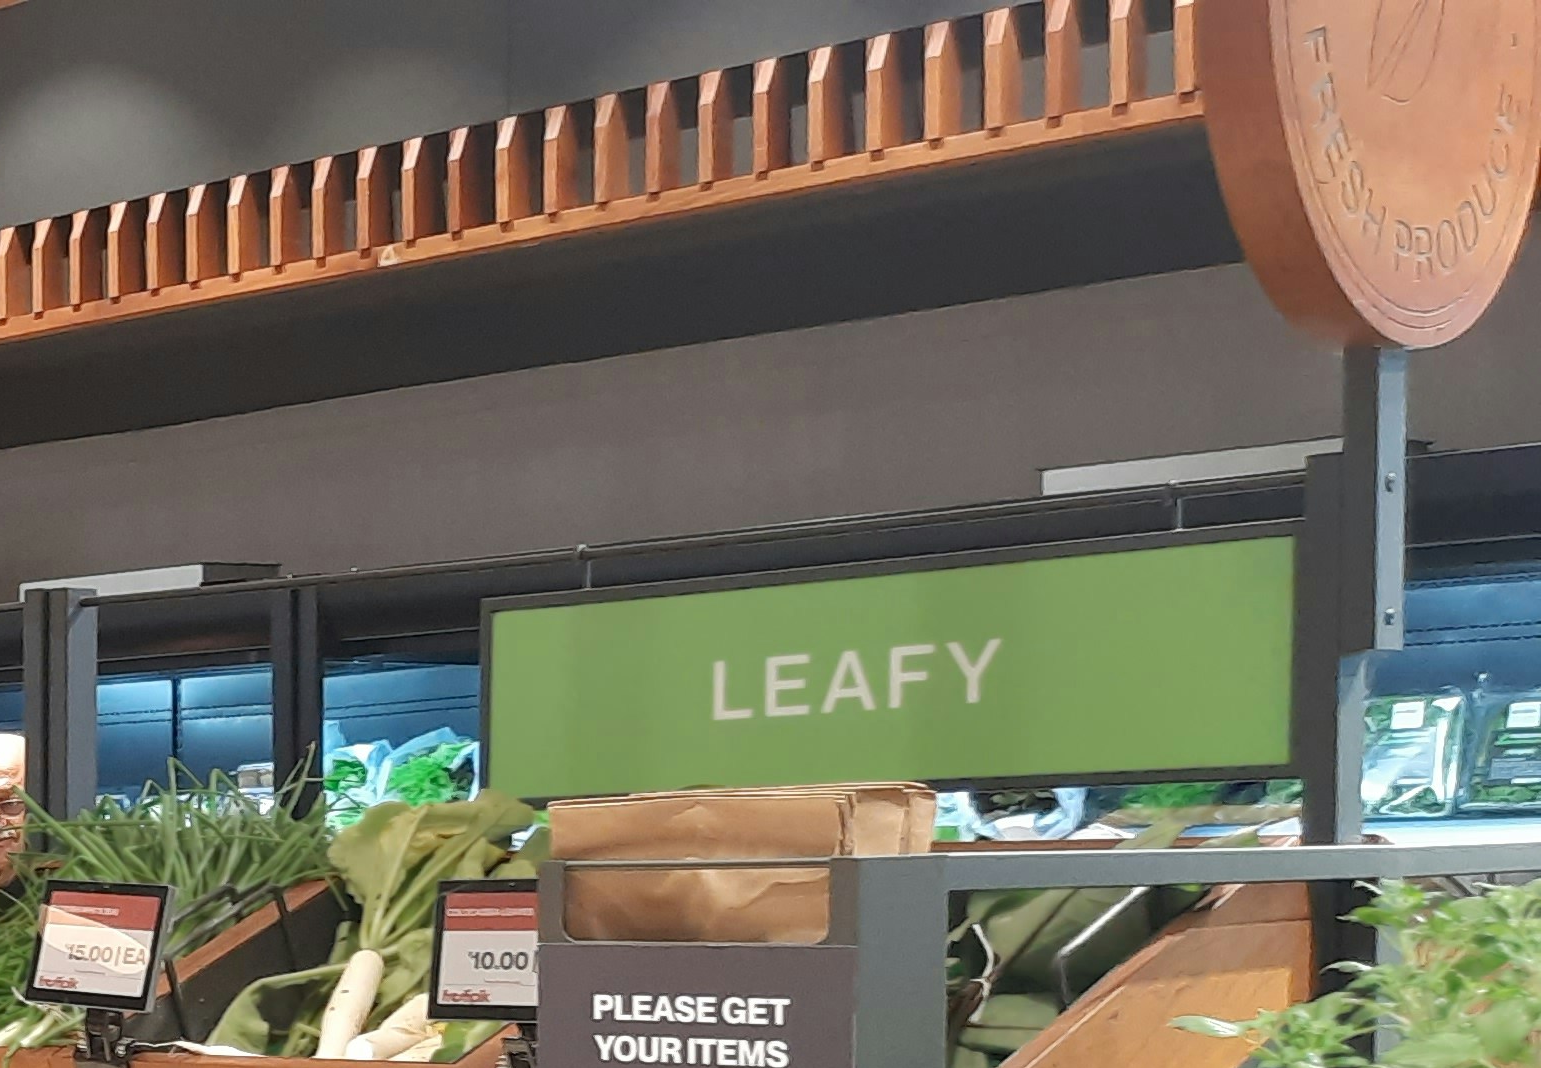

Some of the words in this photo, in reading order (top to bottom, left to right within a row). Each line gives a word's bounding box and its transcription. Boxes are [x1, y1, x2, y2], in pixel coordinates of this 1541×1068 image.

[1303, 25, 1387, 255] FRESH
[1392, 83, 1517, 282] PRODUCE
[712, 638, 1003, 721] LEAFY
[592, 993, 717, 1023] PLEASE
[721, 996, 791, 1026] GET
[593, 1033, 683, 1064] YOUR
[687, 1037, 790, 1068] ITEMS
